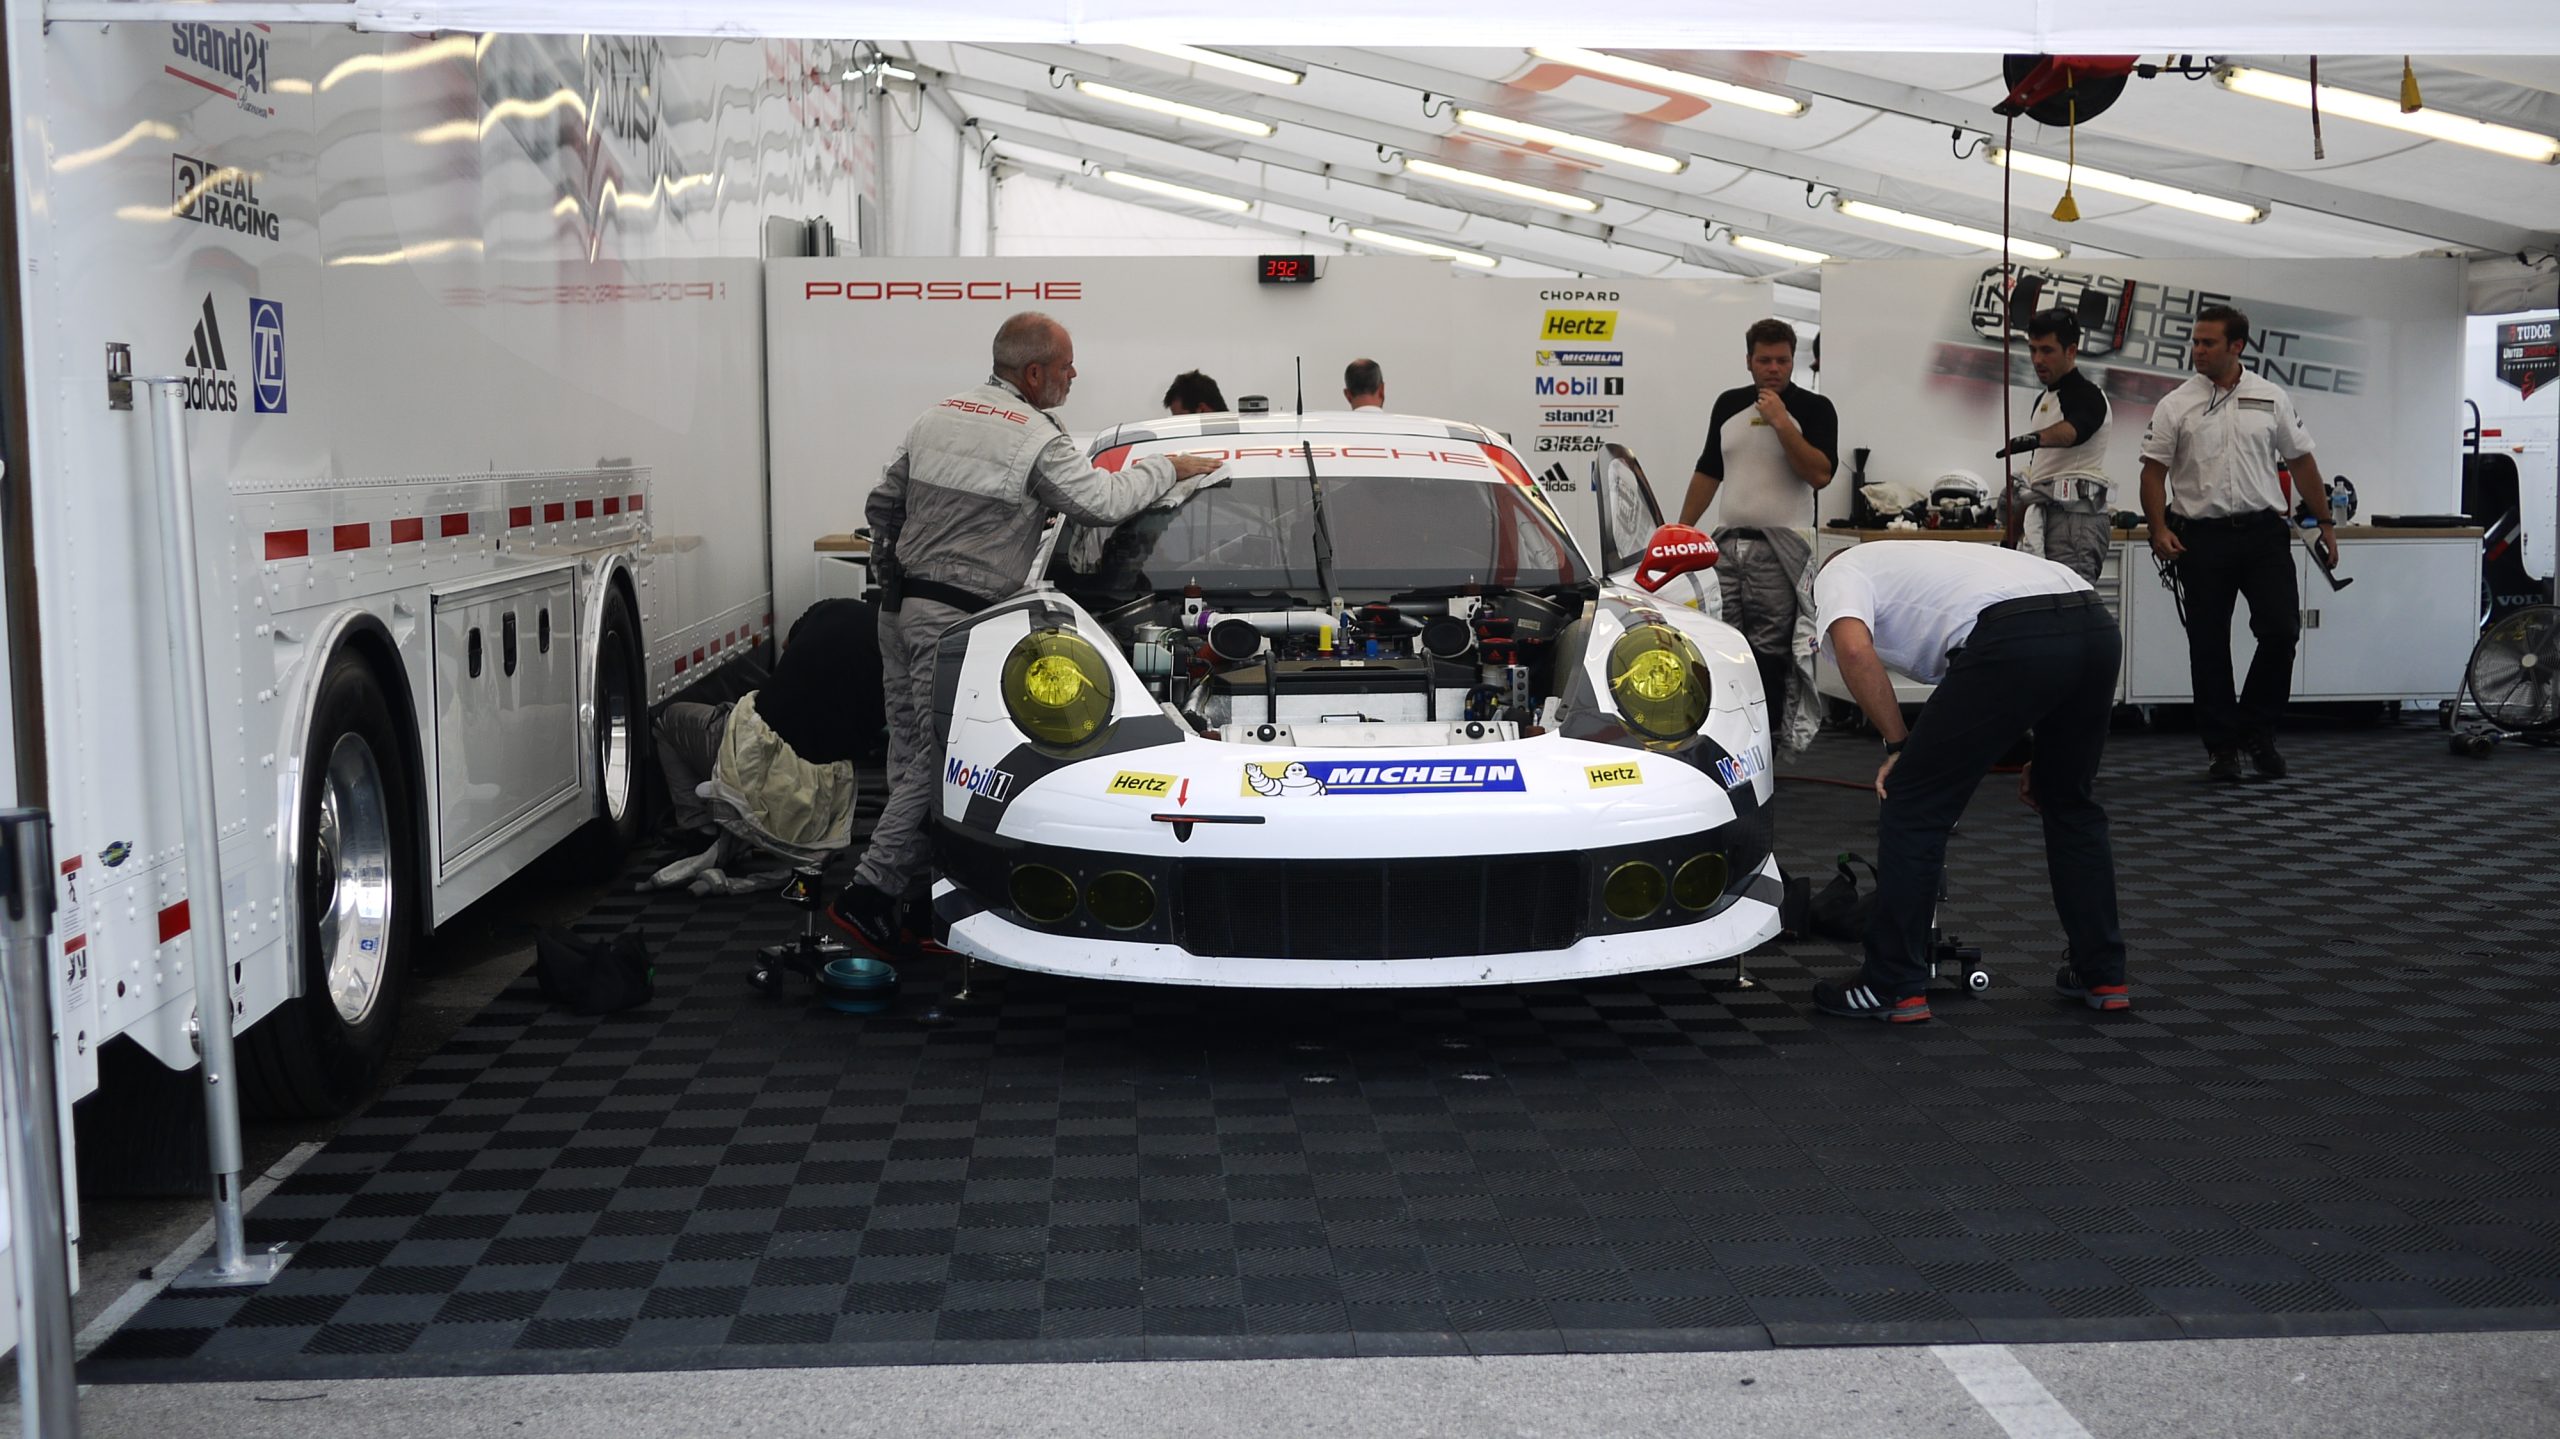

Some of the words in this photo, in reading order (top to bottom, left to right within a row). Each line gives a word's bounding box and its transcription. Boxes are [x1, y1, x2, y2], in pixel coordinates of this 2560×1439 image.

[205, 162, 259, 206] REAL
[205, 194, 279, 242] RACING
[805, 281, 1082, 300] PORSCHE
[1540, 290, 1620, 301] CHOPARD
[1547, 315, 1607, 335] Hertz
[2517, 323, 2552, 340] TUDOR
[256, 325, 283, 387] ZF
[1562, 353, 1622, 362] MICHELIN
[1535, 377, 1597, 395] Mobil
[1545, 408, 1614, 423] stand21
[1539, 438, 1553, 452] 3
[1559, 436, 1605, 444] REAL
[1559, 444, 1603, 452] RACI
[945, 756, 994, 795] Mobil
[1114, 775, 1167, 792] Hertz
[1327, 765, 1515, 785] MICHELIN
[1591, 767, 1636, 783] Hertz
